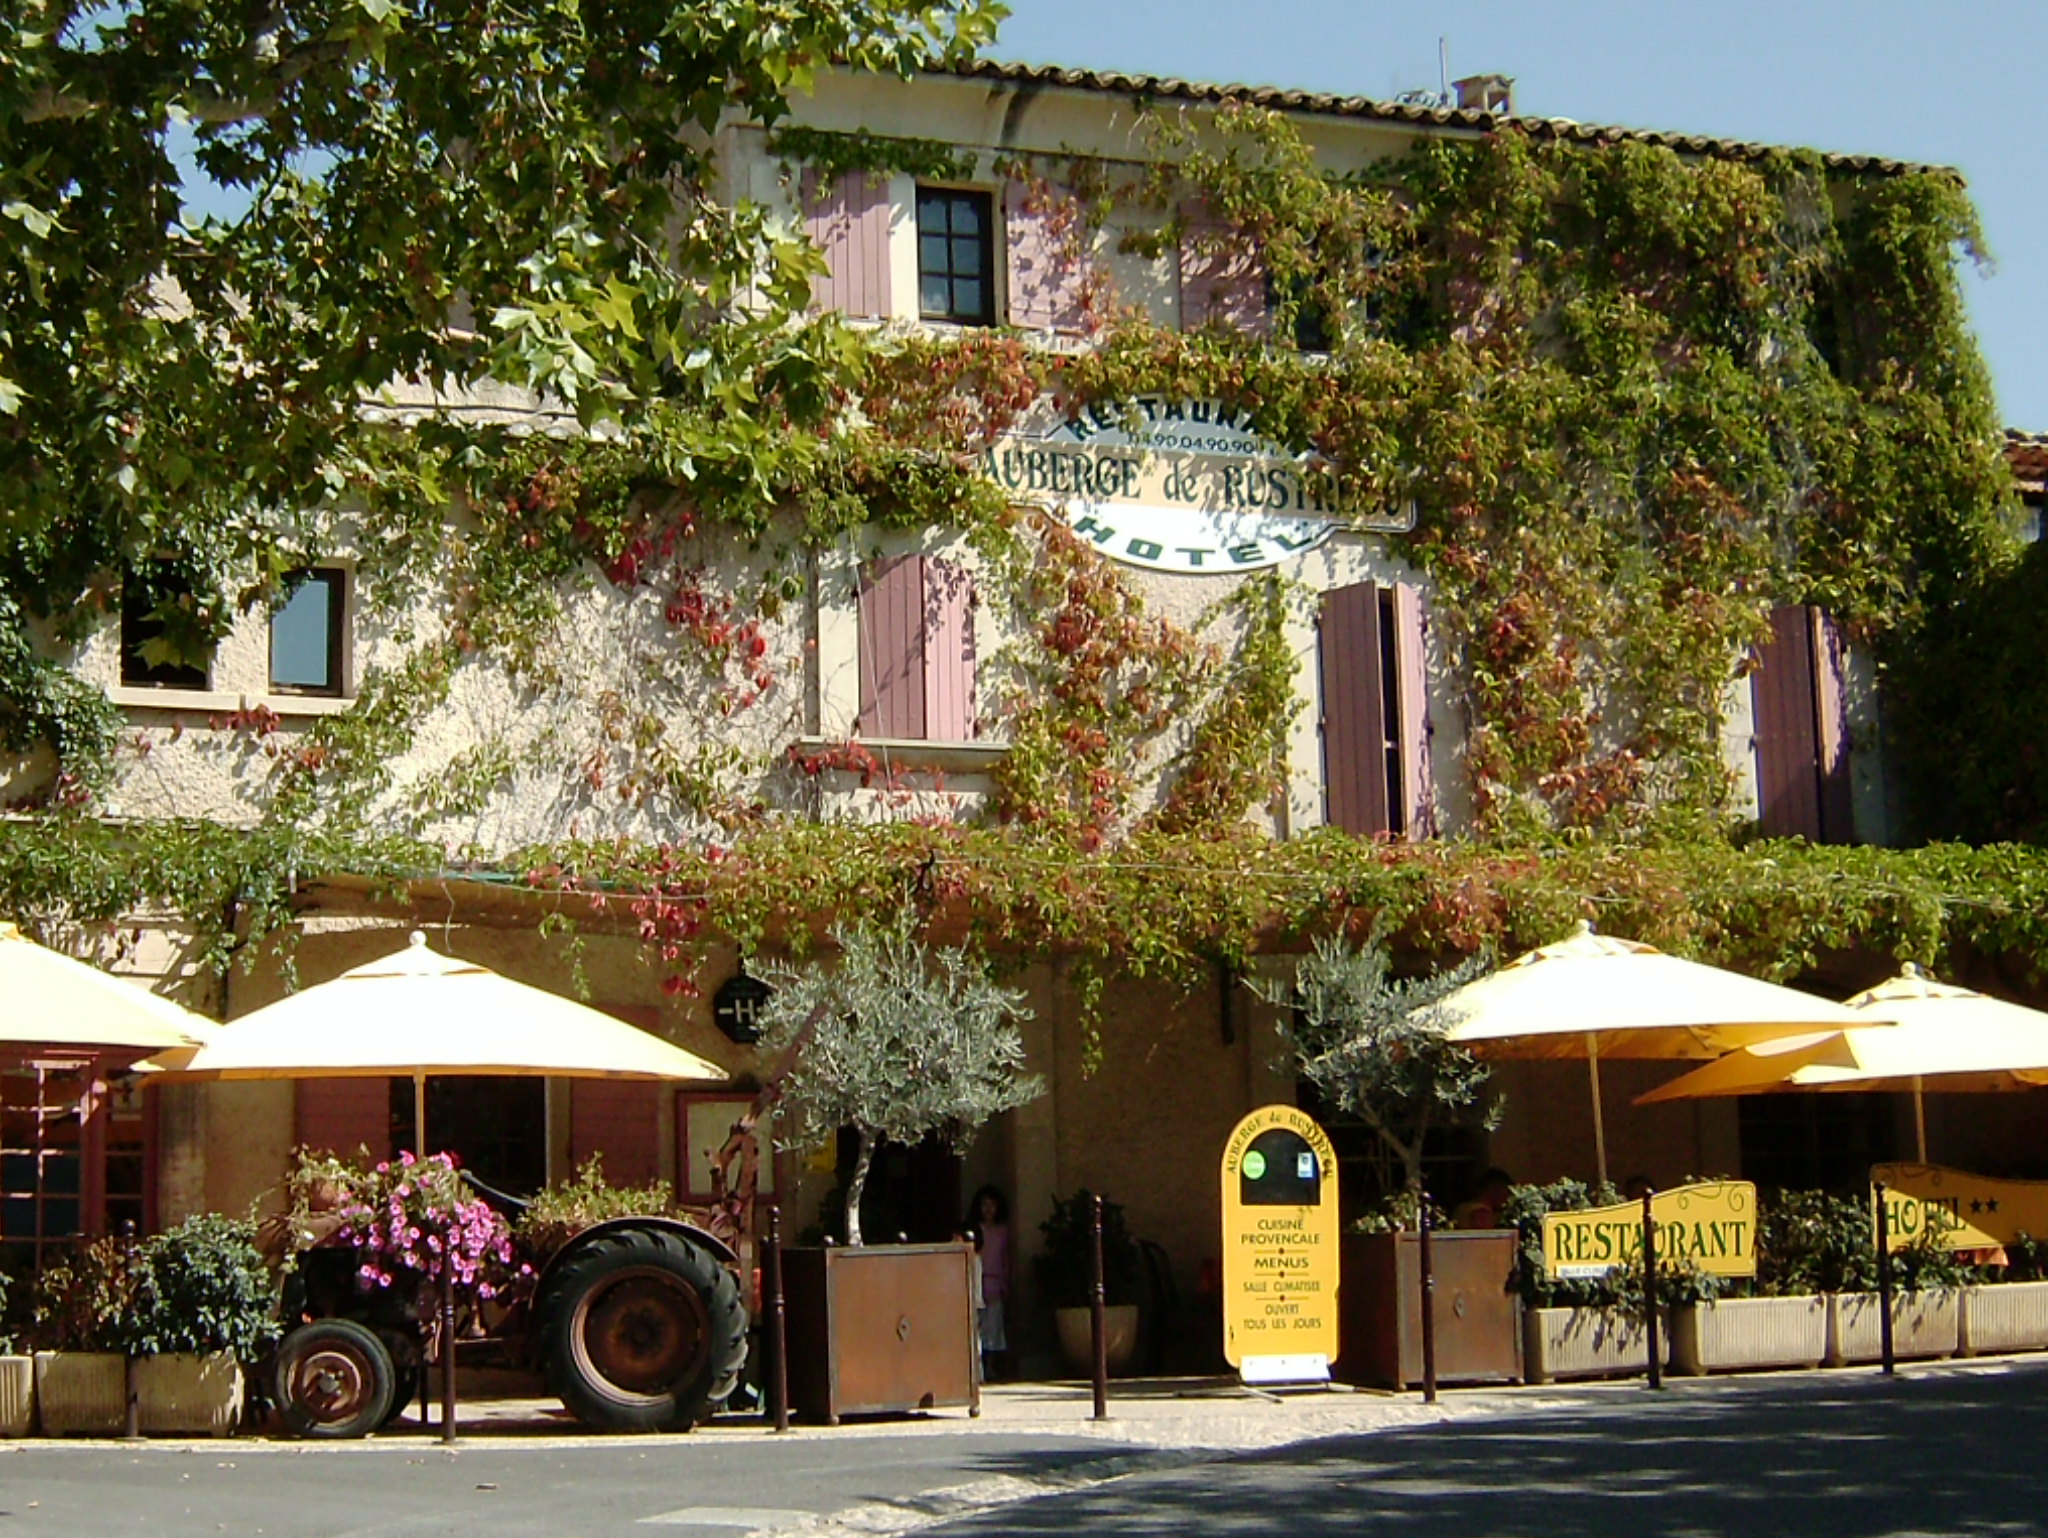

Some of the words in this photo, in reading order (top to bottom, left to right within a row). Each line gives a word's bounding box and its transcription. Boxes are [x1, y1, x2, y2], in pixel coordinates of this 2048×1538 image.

[984, 447, 1142, 499] AUBERGE
[1164, 461, 1198, 502] de
[1072, 516, 1314, 566] HOTEL
[1227, 1116, 1262, 1175] AUBERGE
[1269, 1111, 1283, 1122] de
[1257, 1219, 1304, 1230] CUISINE
[1253, 1257, 1309, 1268] MENUS
[1243, 1281, 1267, 1292] SALLE
[1265, 1304, 1299, 1315] OUVERT
[1243, 1319, 1266, 1329] TOUS
[1272, 1319, 1286, 1329] LES
[1293, 1318, 1321, 1329] JOURS
